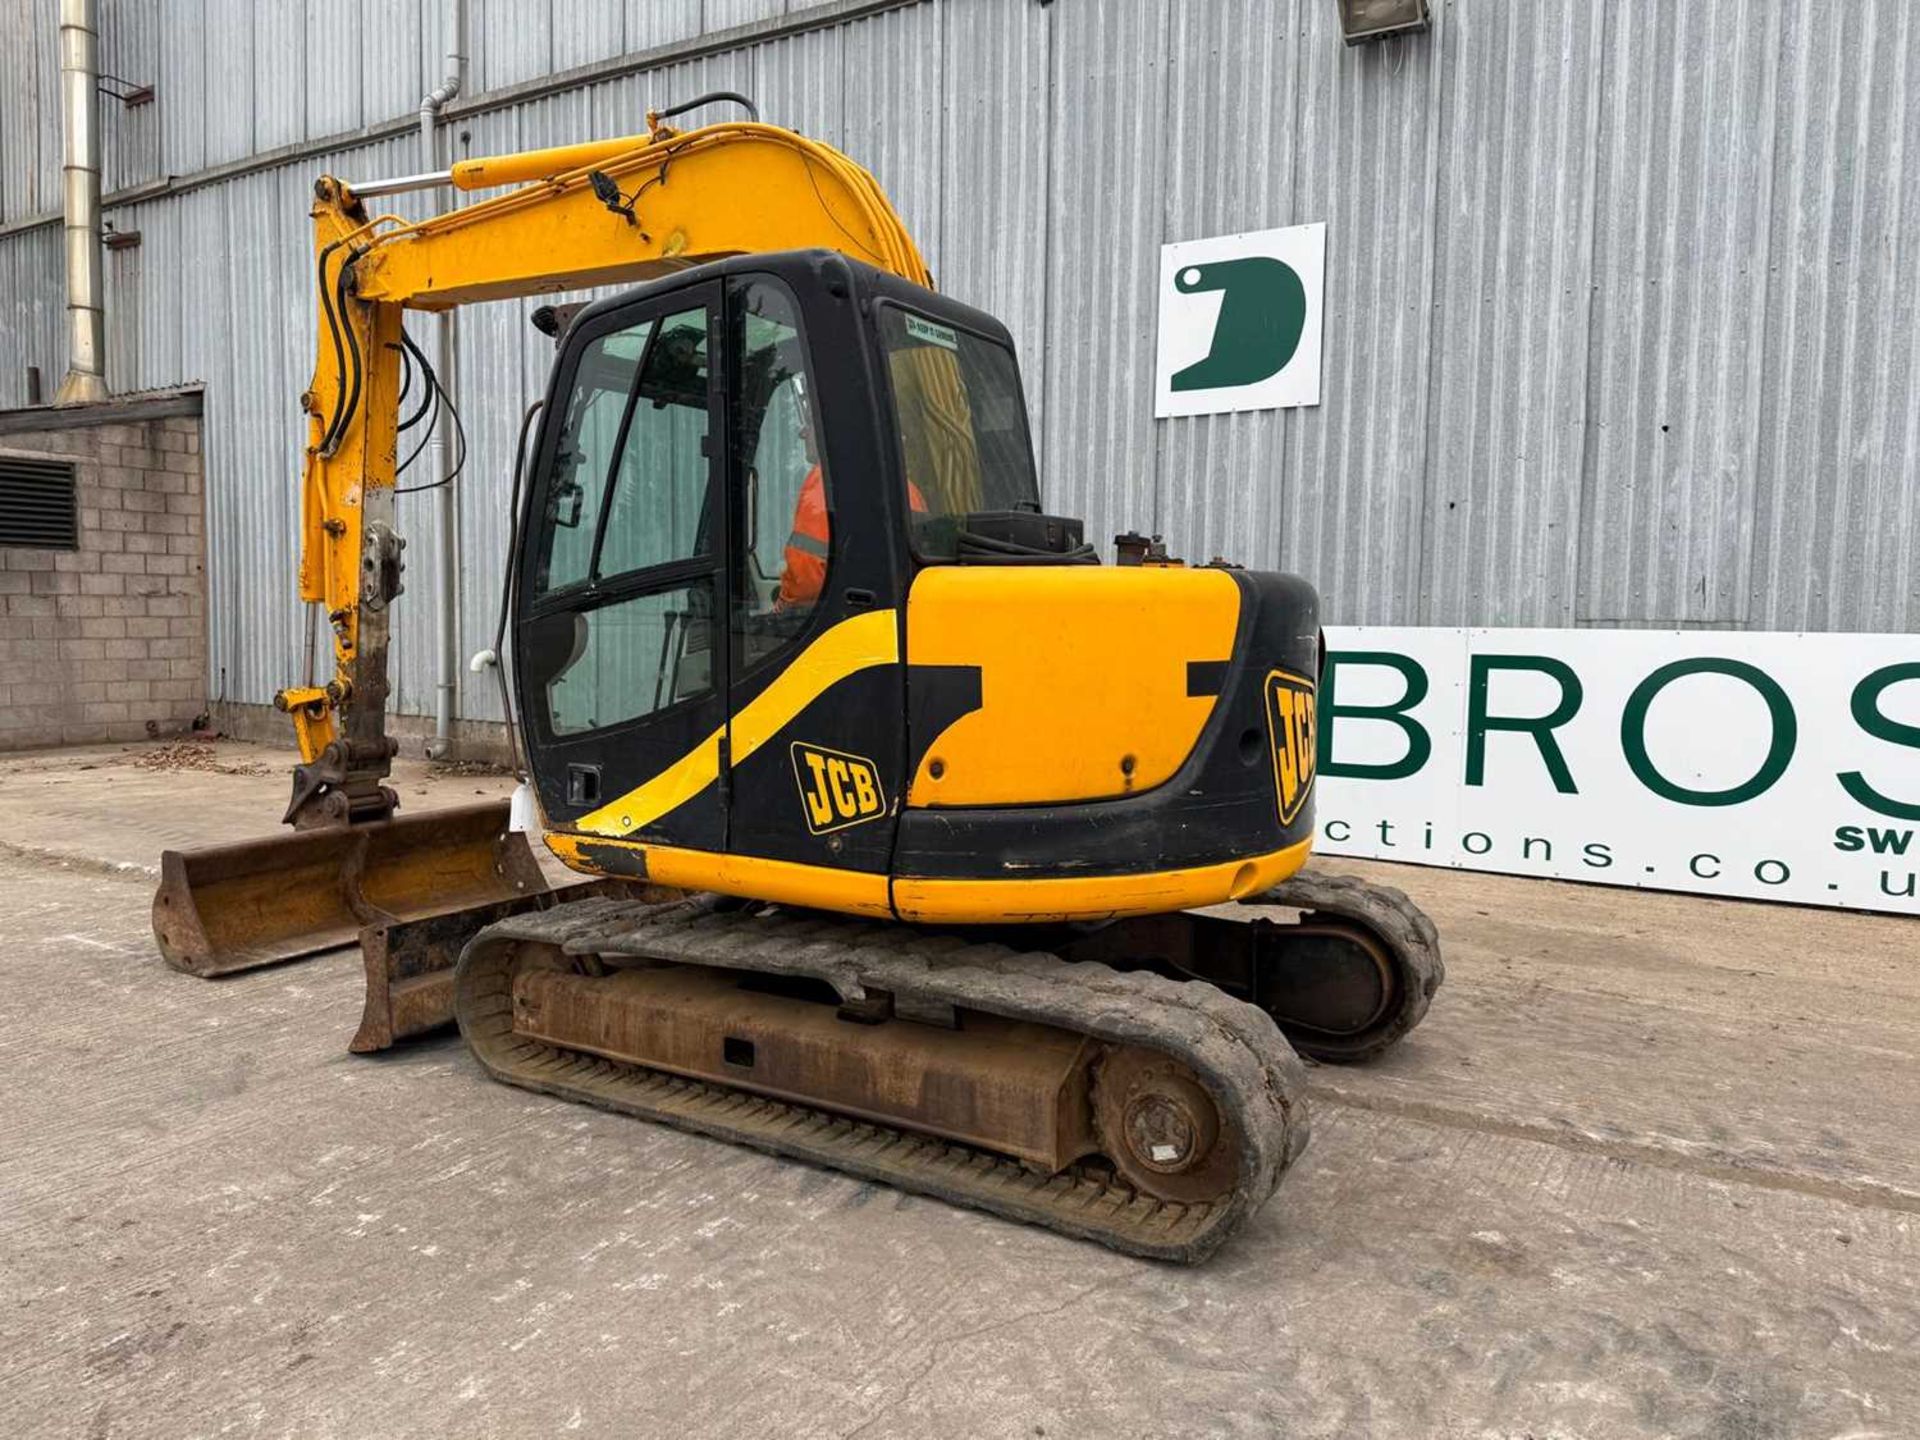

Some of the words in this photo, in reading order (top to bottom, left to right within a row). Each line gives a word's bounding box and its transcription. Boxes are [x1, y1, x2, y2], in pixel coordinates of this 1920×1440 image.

[804, 751, 878, 826] JCB
[1276, 686, 1314, 809] JCB
[1316, 649, 1920, 821] BROS
